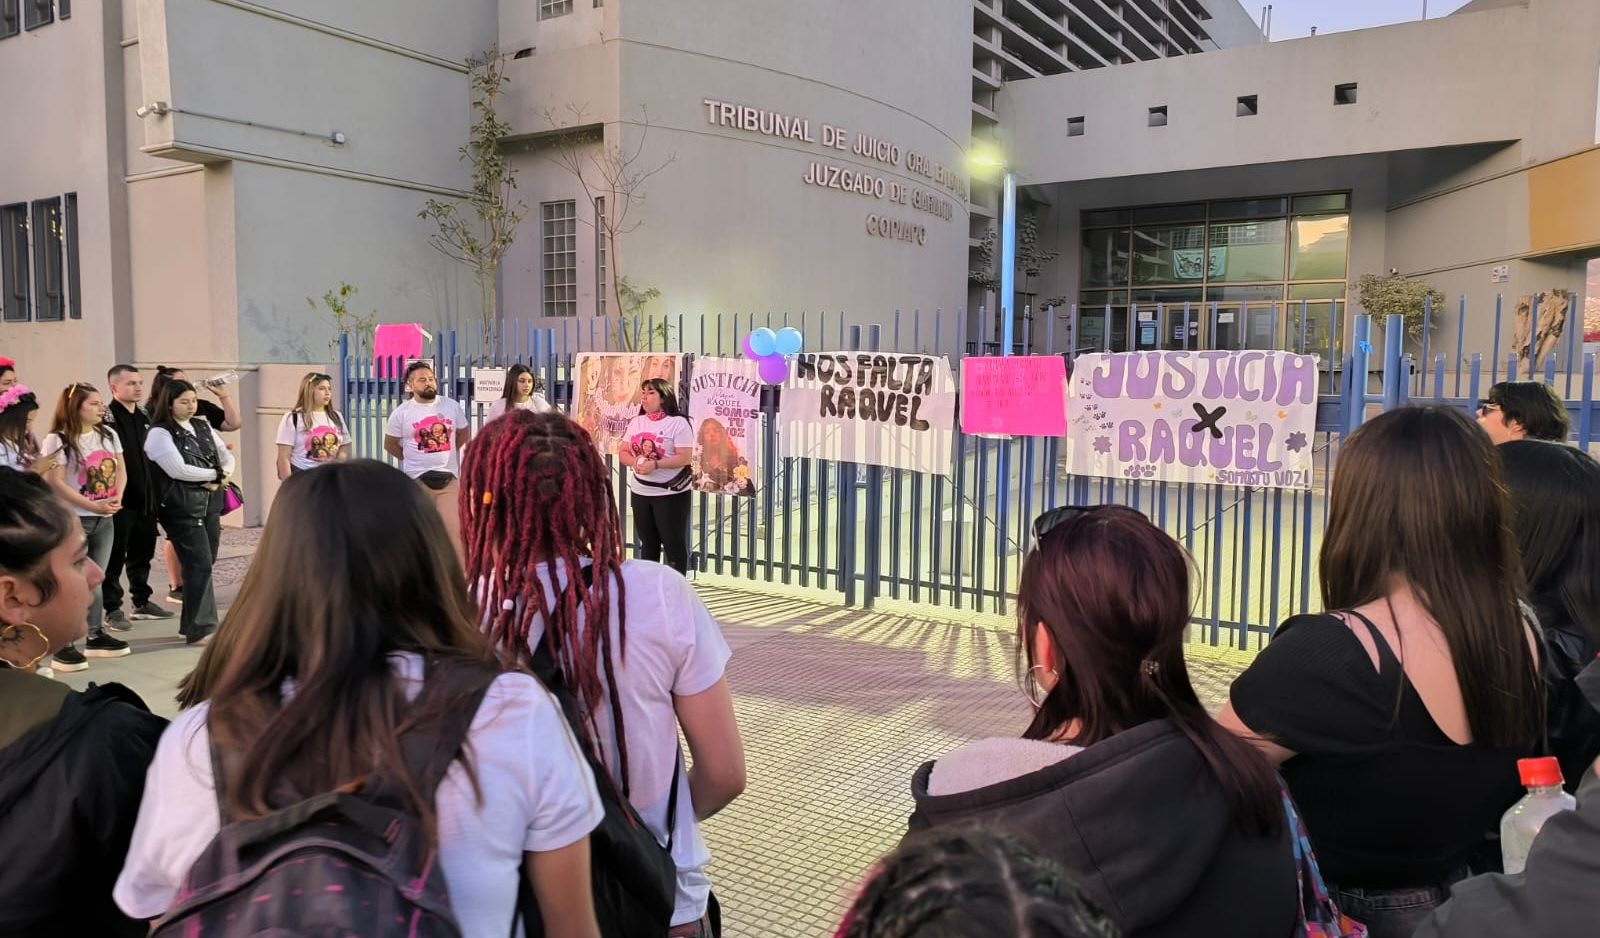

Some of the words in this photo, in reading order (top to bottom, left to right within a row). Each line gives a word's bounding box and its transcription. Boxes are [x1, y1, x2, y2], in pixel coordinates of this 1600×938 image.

[704, 99, 815, 143] TRIBUNAL
[822, 124, 847, 150] DE
[853, 133, 900, 165] JUICIO
[804, 162, 885, 199] JUZGADO
[890, 181, 906, 204] DE
[692, 372, 760, 397] JUSTICIA
[797, 353, 852, 385] NOS
[856, 354, 934, 396] FALTA
[714, 406, 759, 419] SOMOS
[728, 417, 744, 428] TU
[820, 384, 930, 431] RAQUEL
[1119, 418, 1282, 472] RAQUEL
[1274, 468, 1310, 488] VOZ!
